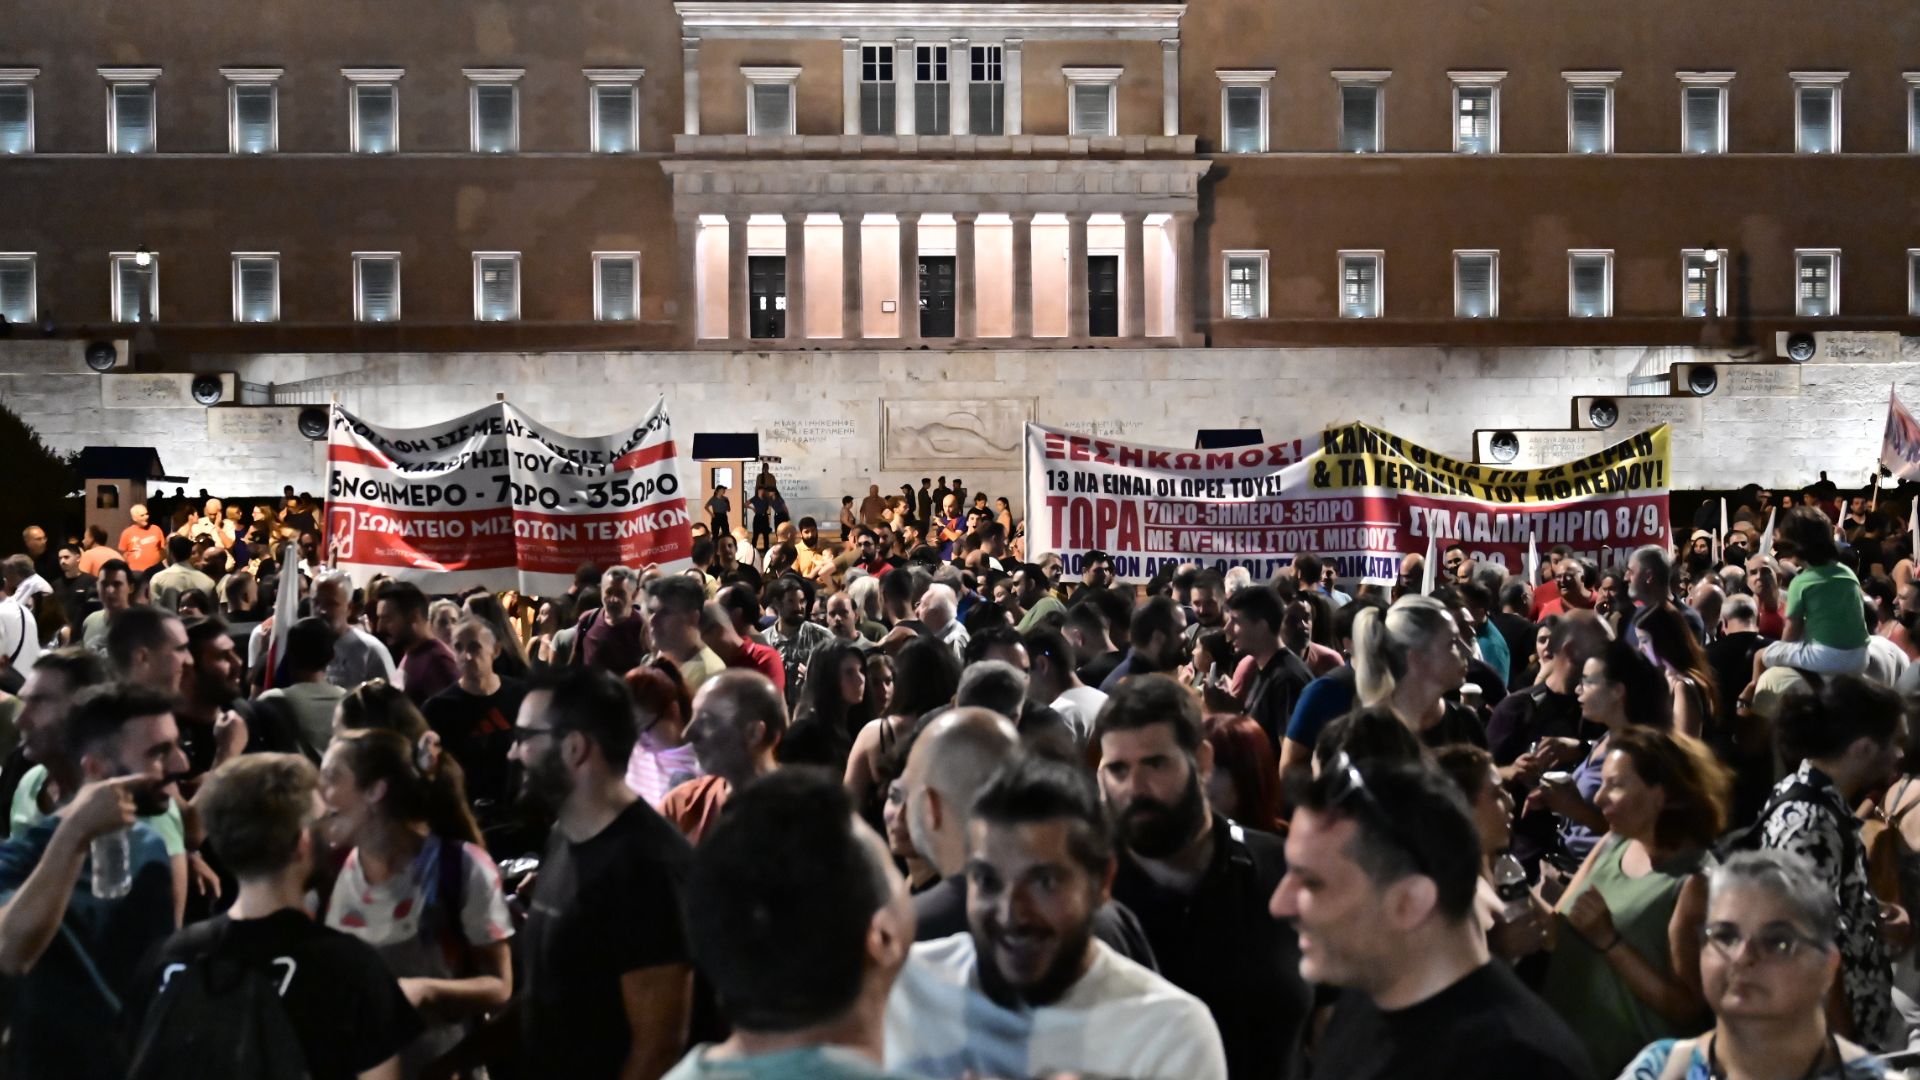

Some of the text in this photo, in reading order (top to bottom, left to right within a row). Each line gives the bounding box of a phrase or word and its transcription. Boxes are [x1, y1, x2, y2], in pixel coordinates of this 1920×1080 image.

[472, 417, 503, 436] ΜΕ
[1323, 427, 1404, 458] ΚΑΜΙΑ
[514, 451, 556, 473] ΤΟΥ
[1045, 432, 1303, 471] ΞΕΣΗΚΩΜΟΣ!
[587, 473, 679, 509] 35ΩΡΟ
[1046, 470, 1282, 498] 13 ΝΑ ΕΙΝΑΙ ΟΙ ΩΡΕΣ ΤΟΥΣ!
[1314, 460, 1330, 488] &
[1338, 459, 1367, 486] ΤΑ
[1479, 483, 1526, 503] ΤΟΥ
[1535, 460, 1664, 501] ΠΟΛΕΜΟΥ!
[358, 507, 691, 541] ΣΩΜΑΤΕΙΟ ΜΙΣΩΤΩΝ ΤΕΧΝΙΚΩΝ
[1046, 495, 1142, 550] ΤΩΡΑ
[1148, 528, 1397, 553] ΜΕ ΑΥΞΗΣΕΙΣ ΣΤΟΥΣ ΜΙΣΘΟΥΣ
